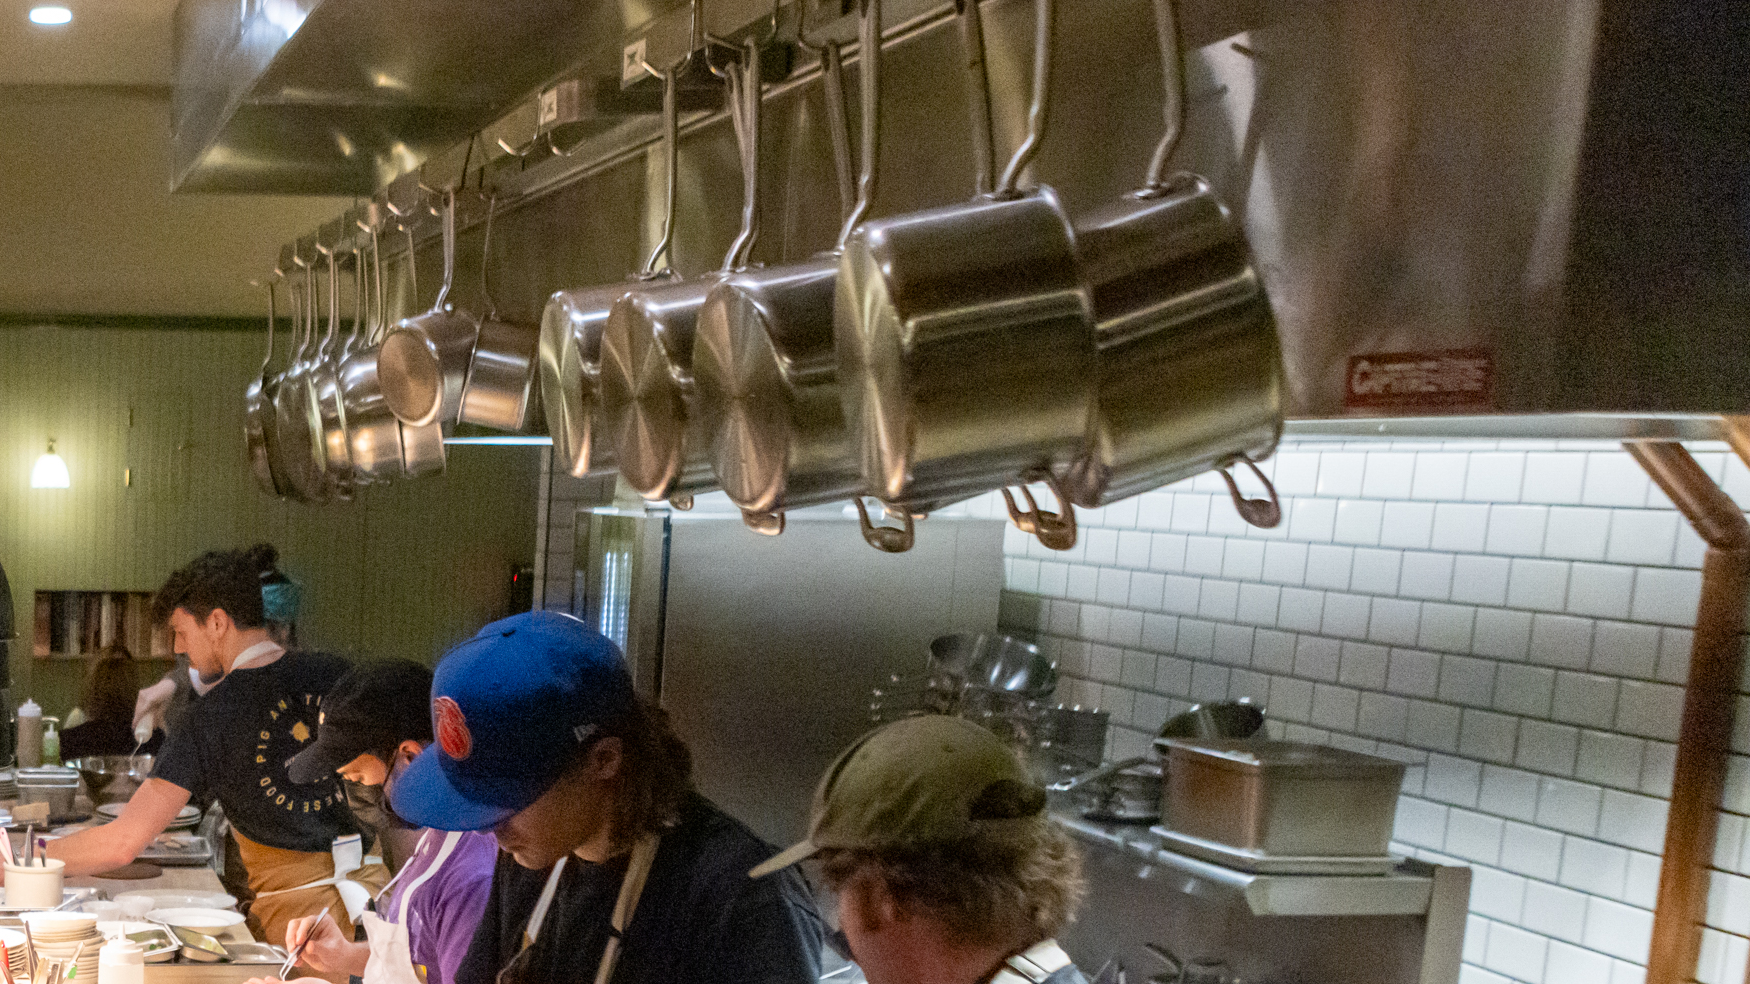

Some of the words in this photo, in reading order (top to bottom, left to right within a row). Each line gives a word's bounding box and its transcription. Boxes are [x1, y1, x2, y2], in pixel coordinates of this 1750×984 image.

[256, 730, 270, 763] PIG
[270, 699, 289, 720] AN
[260, 777, 294, 811] FOOD
